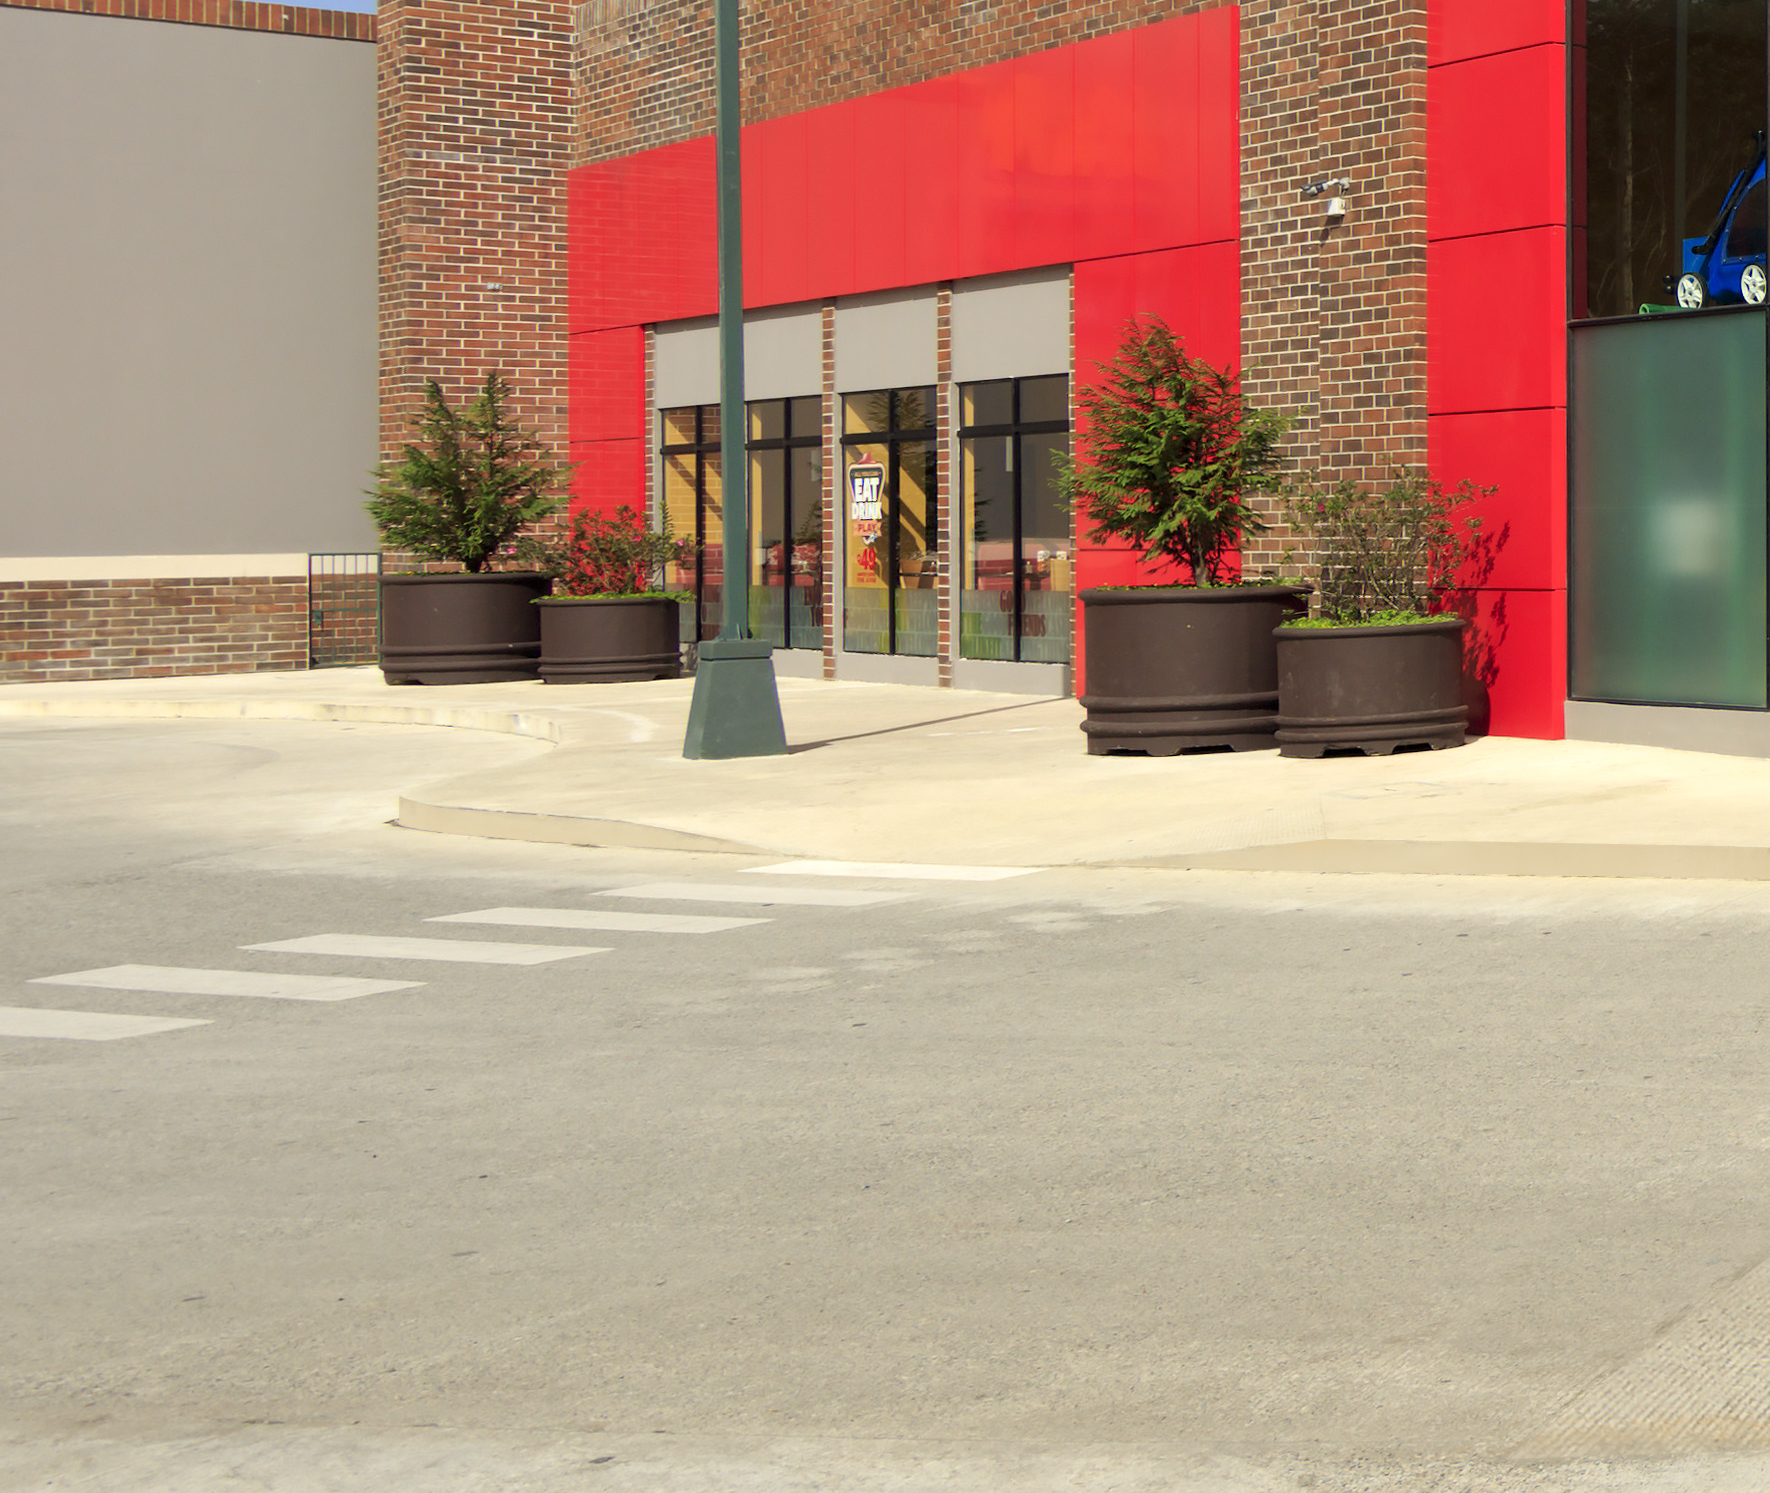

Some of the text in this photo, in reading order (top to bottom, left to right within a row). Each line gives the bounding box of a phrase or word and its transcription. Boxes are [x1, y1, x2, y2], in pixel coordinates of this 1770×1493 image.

[854, 477, 880, 502] EAT
[851, 502, 882, 520] DRINK
[858, 523, 877, 533] PLAY
